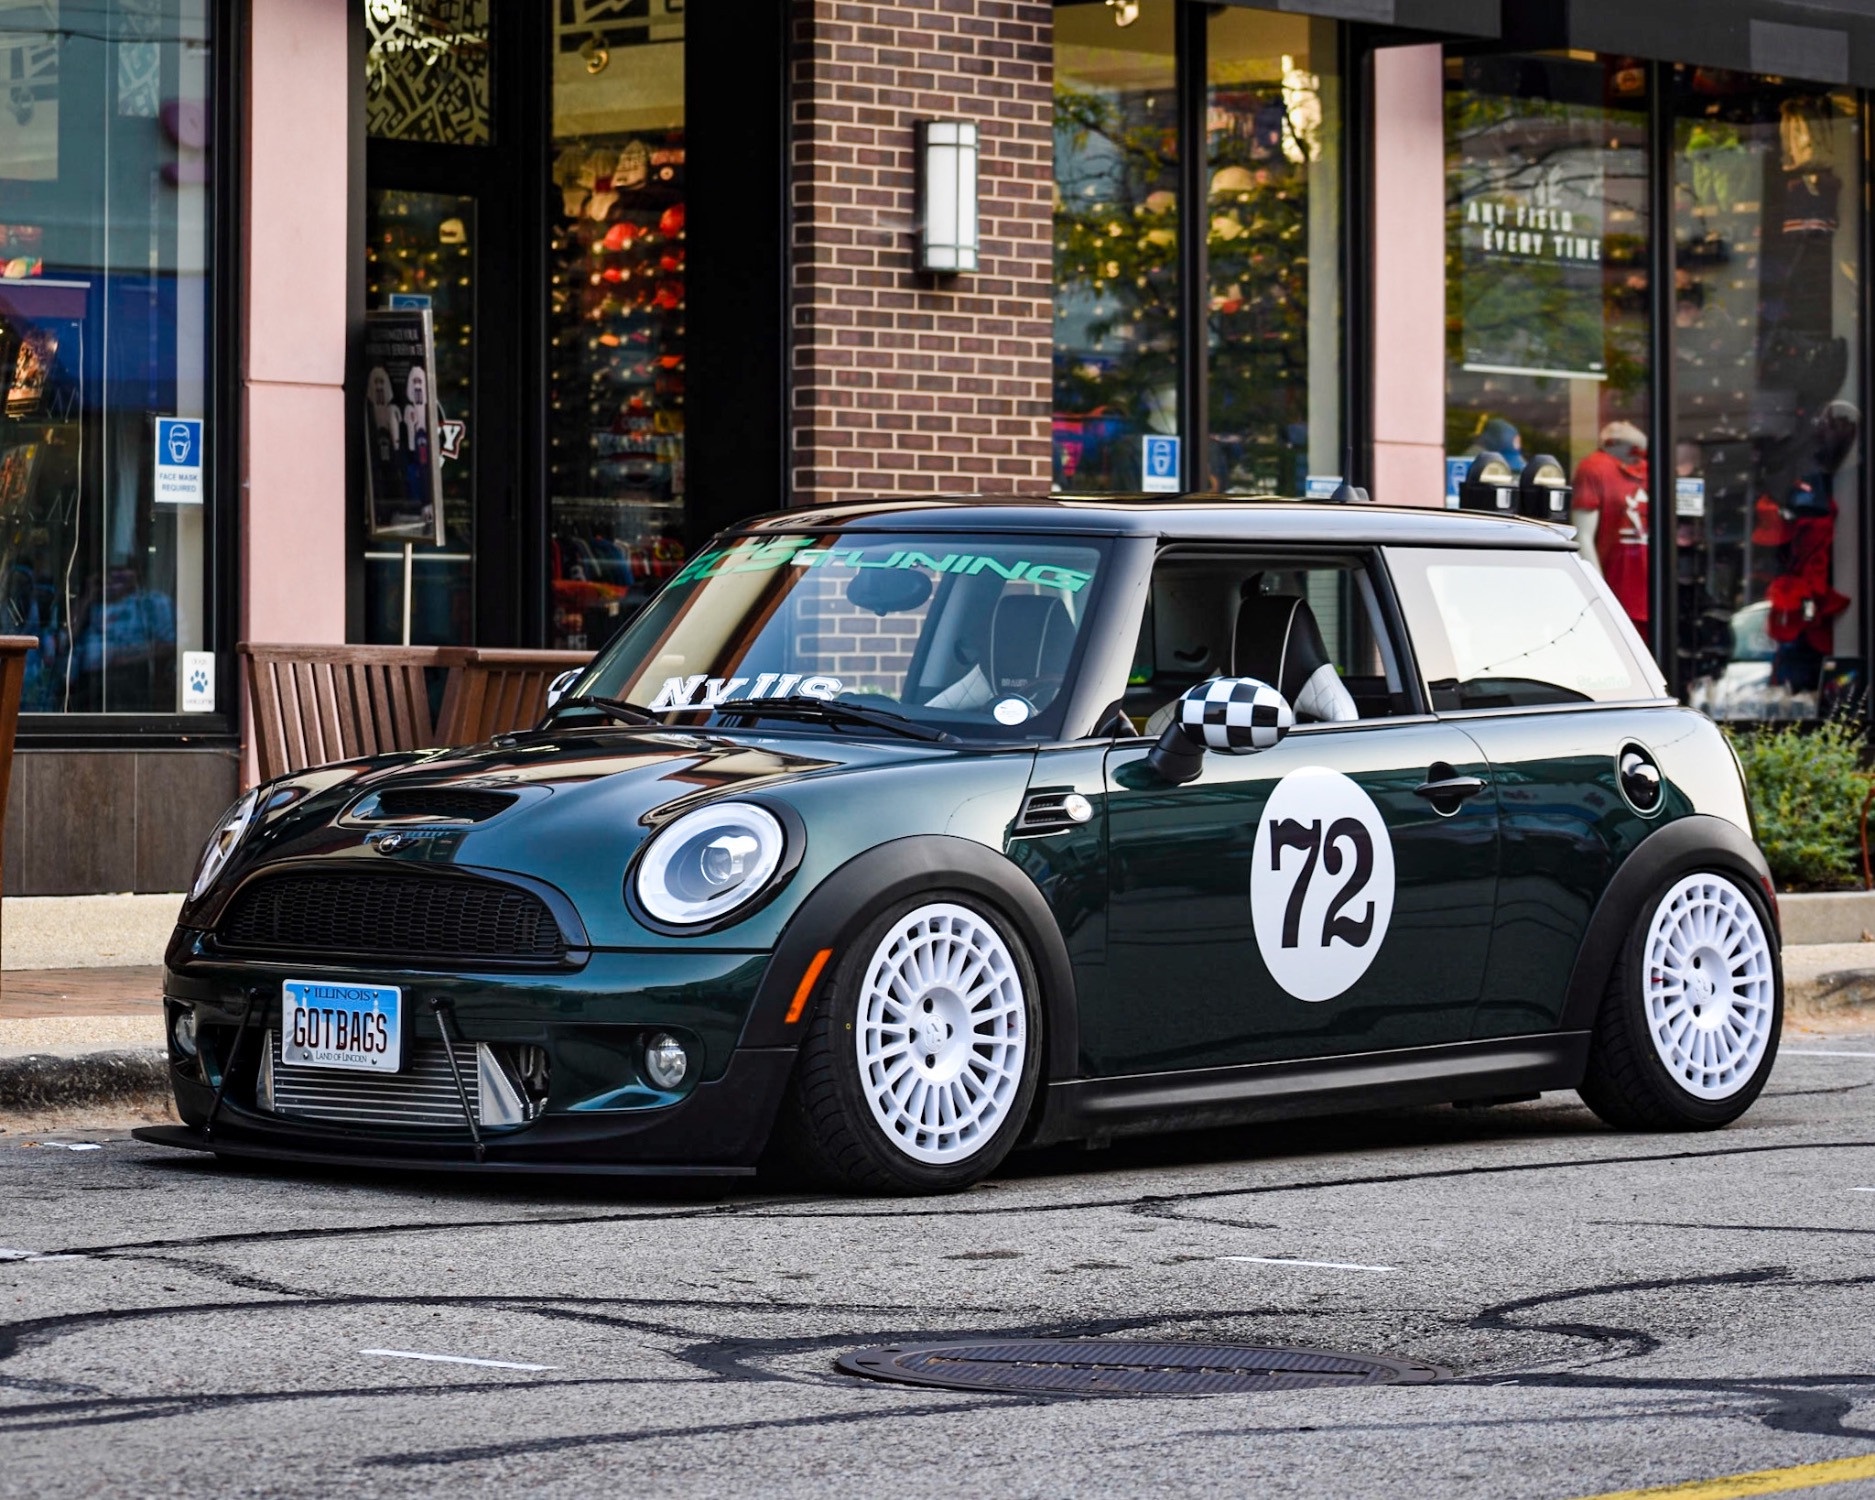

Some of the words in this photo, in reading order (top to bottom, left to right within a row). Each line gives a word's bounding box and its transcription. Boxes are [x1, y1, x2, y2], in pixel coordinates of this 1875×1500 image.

[1467, 201, 1505, 225] ANY
[1517, 206, 1572, 231] FIELD
[1483, 228, 1543, 255] EVERY
[1553, 235, 1600, 260] TIME
[162, 484, 197, 492] REQUIRED
[178, 473, 198, 481] MASK
[790, 549, 1092, 592] TUNING
[1269, 817, 1375, 948] 72
[315, 987, 371, 1001] ILLINOIS
[294, 1007, 387, 1054] GOTBAGS
